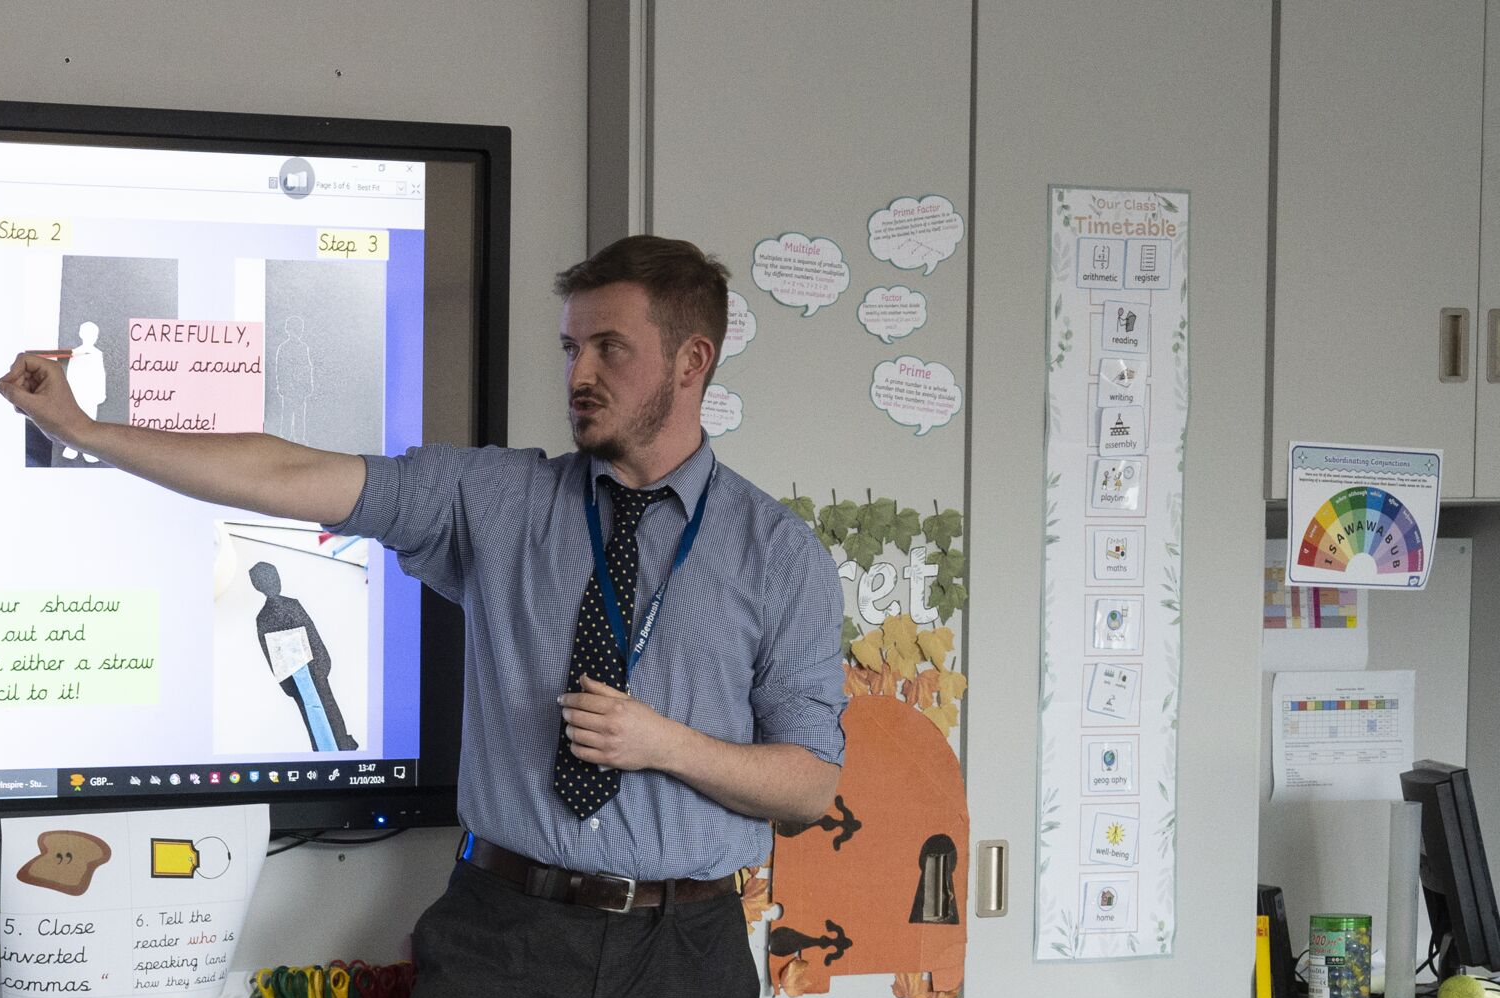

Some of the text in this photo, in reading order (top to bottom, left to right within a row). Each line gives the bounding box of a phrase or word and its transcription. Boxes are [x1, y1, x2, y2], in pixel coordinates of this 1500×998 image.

[893, 205, 940, 217] Prime Factor
[1097, 199, 1156, 211] Our Class
[50, 223, 61, 242] 2
[1074, 215, 1176, 237] Timetable
[319, 233, 377, 258] Step 3
[785, 242, 820, 256] Multiple
[1083, 273, 1118, 282] arithmetic
[1135, 275, 1160, 283] register
[131, 323, 249, 348] CAREFULLY,
[1112, 334, 1138, 347] reading
[130, 353, 261, 373] draw around
[900, 363, 931, 379] Prime
[130, 389, 175, 407] your
[1109, 392, 1133, 404] writing
[131, 413, 216, 431] template!
[1104, 439, 1137, 450] assembly
[1324, 456, 1369, 465] Subordinating
[40, 595, 120, 613] shadow
[1, 625, 37, 642] out
[45, 623, 86, 641] and
[634, 601, 659, 653] The Bewbush
[10, 653, 65, 671] either
[74, 659, 91, 670] a
[98, 654, 154, 670] straw
[27, 684, 47, 700] to
[58, 682, 80, 700] it!
[358, 764, 376, 772] 13:47
[350, 776, 385, 784] 11/10/2024
[1096, 847, 1130, 860] well-being
[136, 910, 212, 927] 6. Tell the
[1096, 913, 1115, 922] home
[3, 918, 96, 936] 5. Close
[134, 931, 234, 949] reader who is
[1, 946, 88, 964] inverted
[134, 954, 198, 975] speaking
[1, 976, 92, 992] commas
[134, 970, 216, 989] how they said
